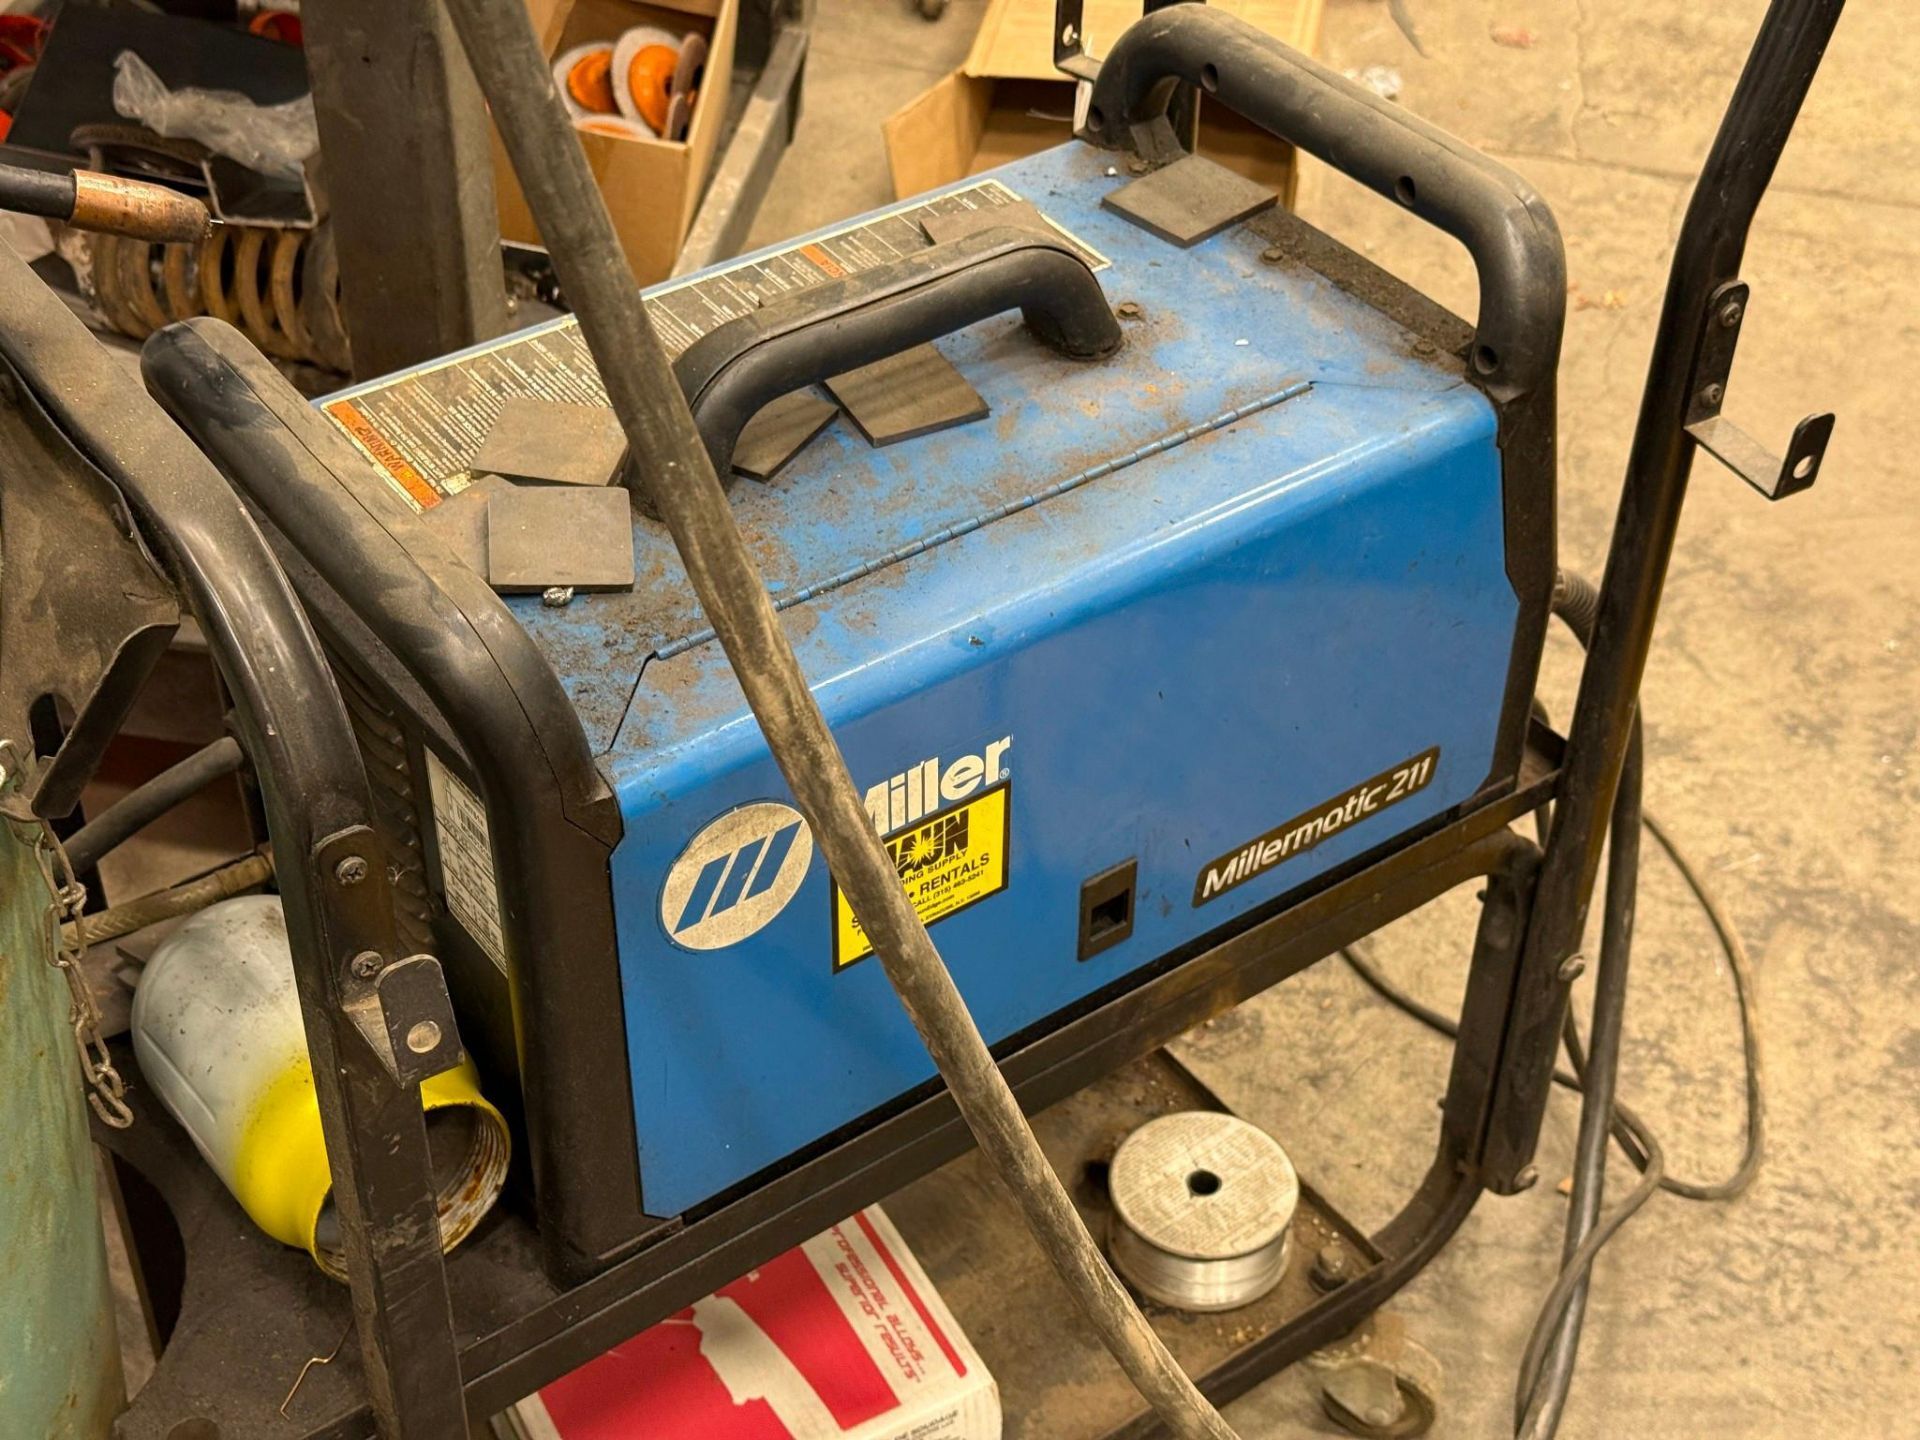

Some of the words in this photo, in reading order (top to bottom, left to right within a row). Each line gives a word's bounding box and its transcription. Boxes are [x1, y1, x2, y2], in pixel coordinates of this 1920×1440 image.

[886, 808, 969, 879] AUN
[1203, 786, 1382, 898] Millermatic
[1385, 756, 1431, 801] 211
[920, 852, 990, 895] RENTALS
[928, 848, 968, 873] SUPPLY
[835, 1261, 881, 1321] SUPERIOR
